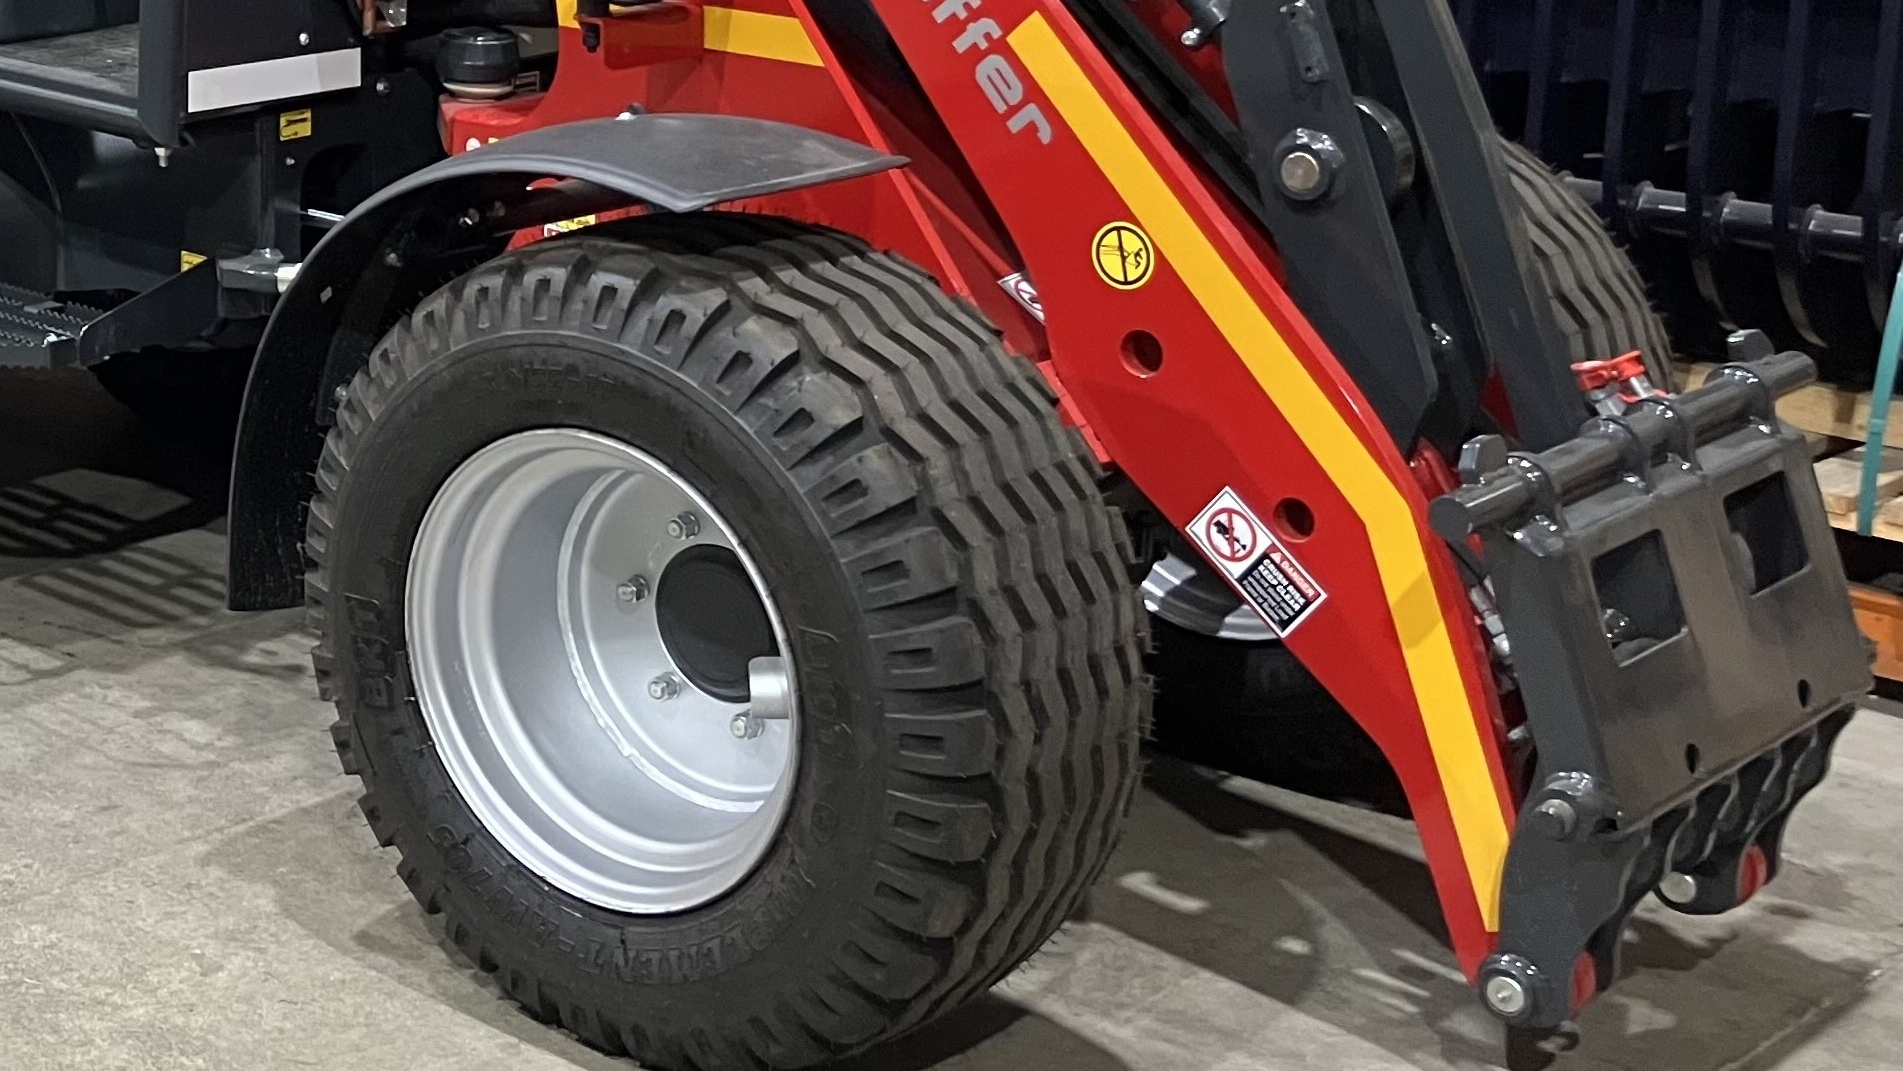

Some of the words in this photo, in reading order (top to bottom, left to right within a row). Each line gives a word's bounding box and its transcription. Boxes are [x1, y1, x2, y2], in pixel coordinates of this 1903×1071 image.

[1257, 564, 1279, 586] KEEP
[1275, 585, 1302, 612] CLEAR
[1263, 558, 1289, 587] CRUSH
[1280, 560, 1315, 597] DANGER
